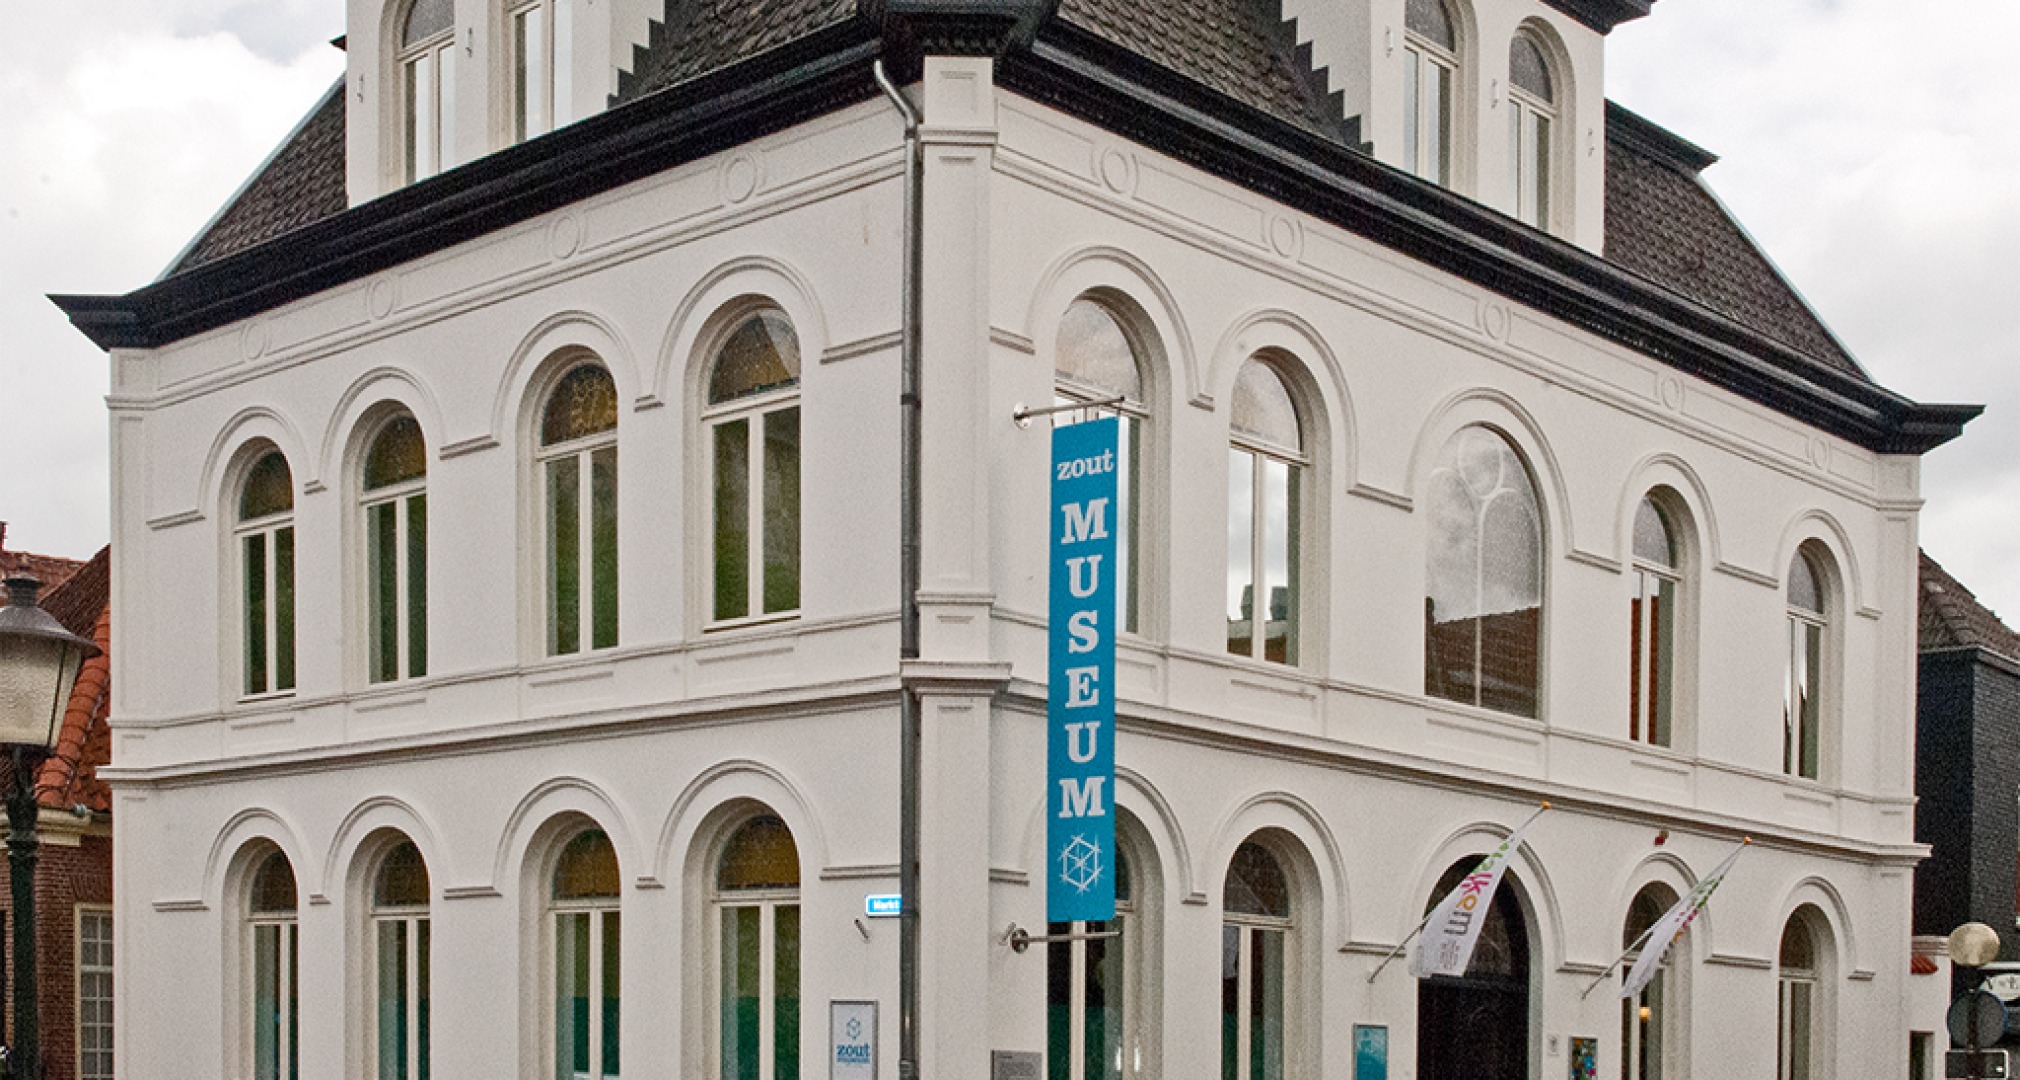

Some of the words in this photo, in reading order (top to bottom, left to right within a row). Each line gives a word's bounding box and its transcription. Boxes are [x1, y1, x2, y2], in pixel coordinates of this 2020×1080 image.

[1057, 448, 1113, 480] zout
[1058, 498, 1109, 818] MUSEUM
[836, 1043, 870, 1056] zout
